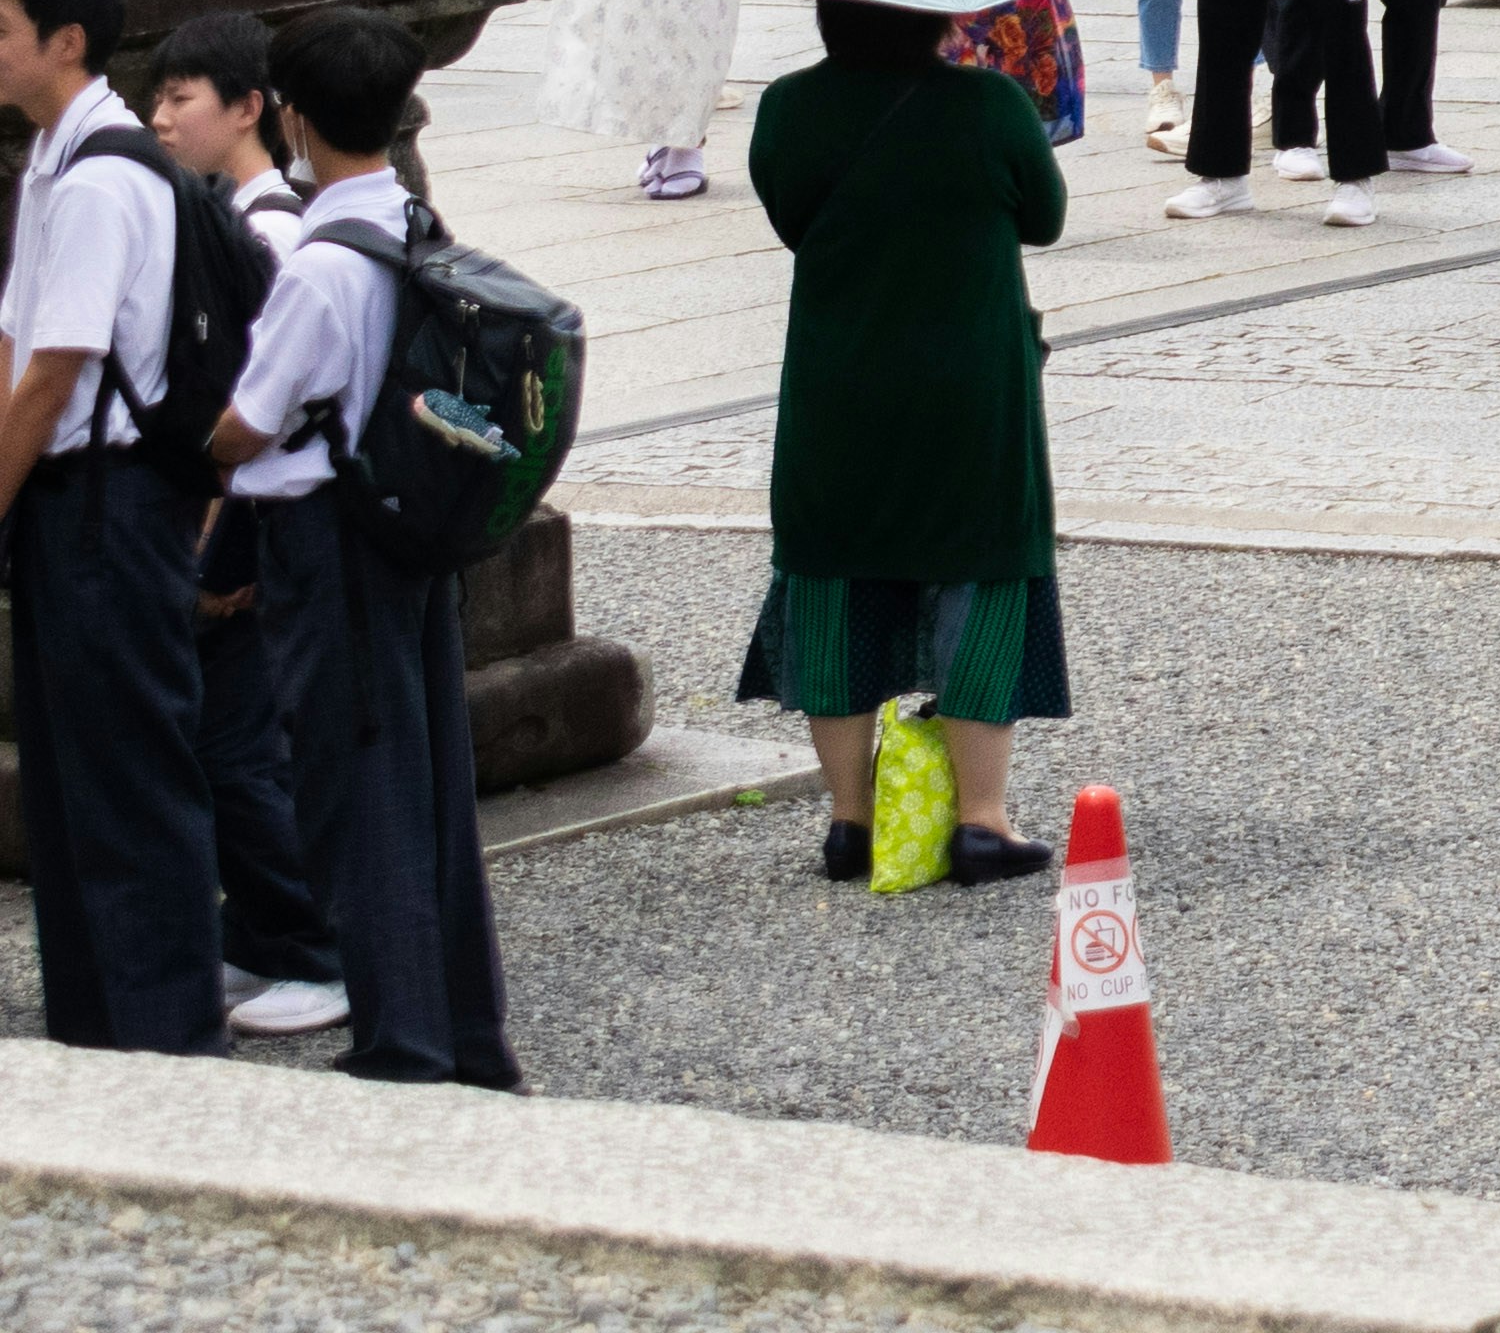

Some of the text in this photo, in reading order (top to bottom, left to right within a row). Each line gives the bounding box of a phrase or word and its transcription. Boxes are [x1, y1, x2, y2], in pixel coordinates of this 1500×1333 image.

[1069, 889, 1099, 910] NO
[1067, 982, 1089, 1001] NO
[1101, 975, 1134, 997] CUP
